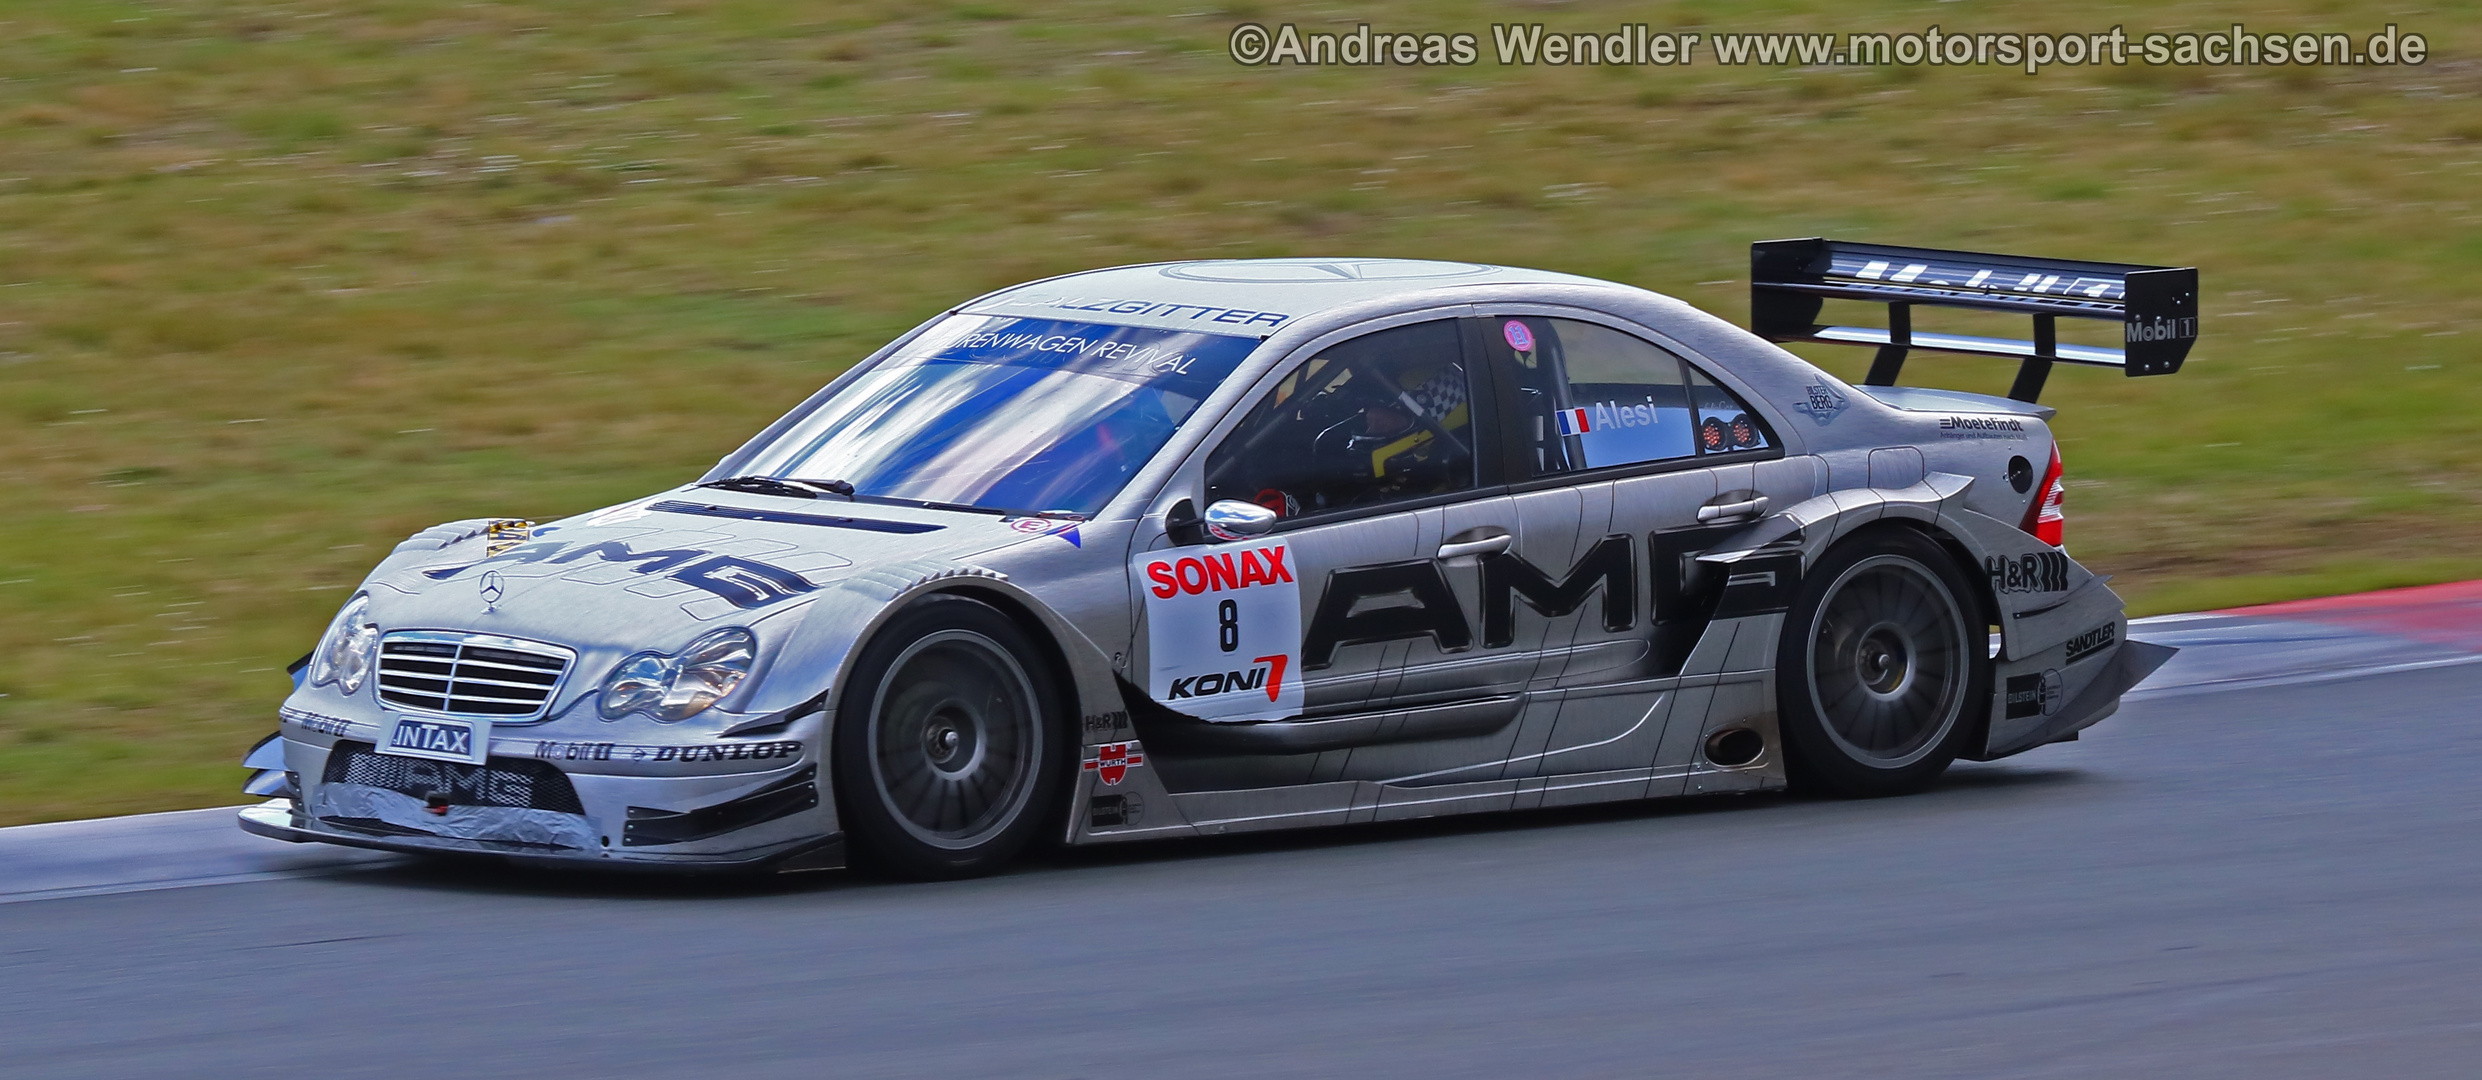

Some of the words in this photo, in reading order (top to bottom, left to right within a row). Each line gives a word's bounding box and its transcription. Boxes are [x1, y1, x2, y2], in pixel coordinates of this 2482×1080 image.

[2127, 318, 2176, 342] Mobil
[1097, 340, 1198, 375] REVIVAL
[1595, 395, 1659, 431] Alesi
[1147, 545, 1294, 599] SONAX
[1986, 553, 2040, 592] H&R
[1301, 523, 1807, 671] AMG
[1218, 599, 1239, 652] 8
[2065, 621, 2116, 657] SANDTLER
[1168, 667, 1267, 700] KONI
[2007, 689, 2036, 704] BILSTEIN
[395, 724, 469, 753] INTAX
[652, 742, 802, 762] DUNLOP
